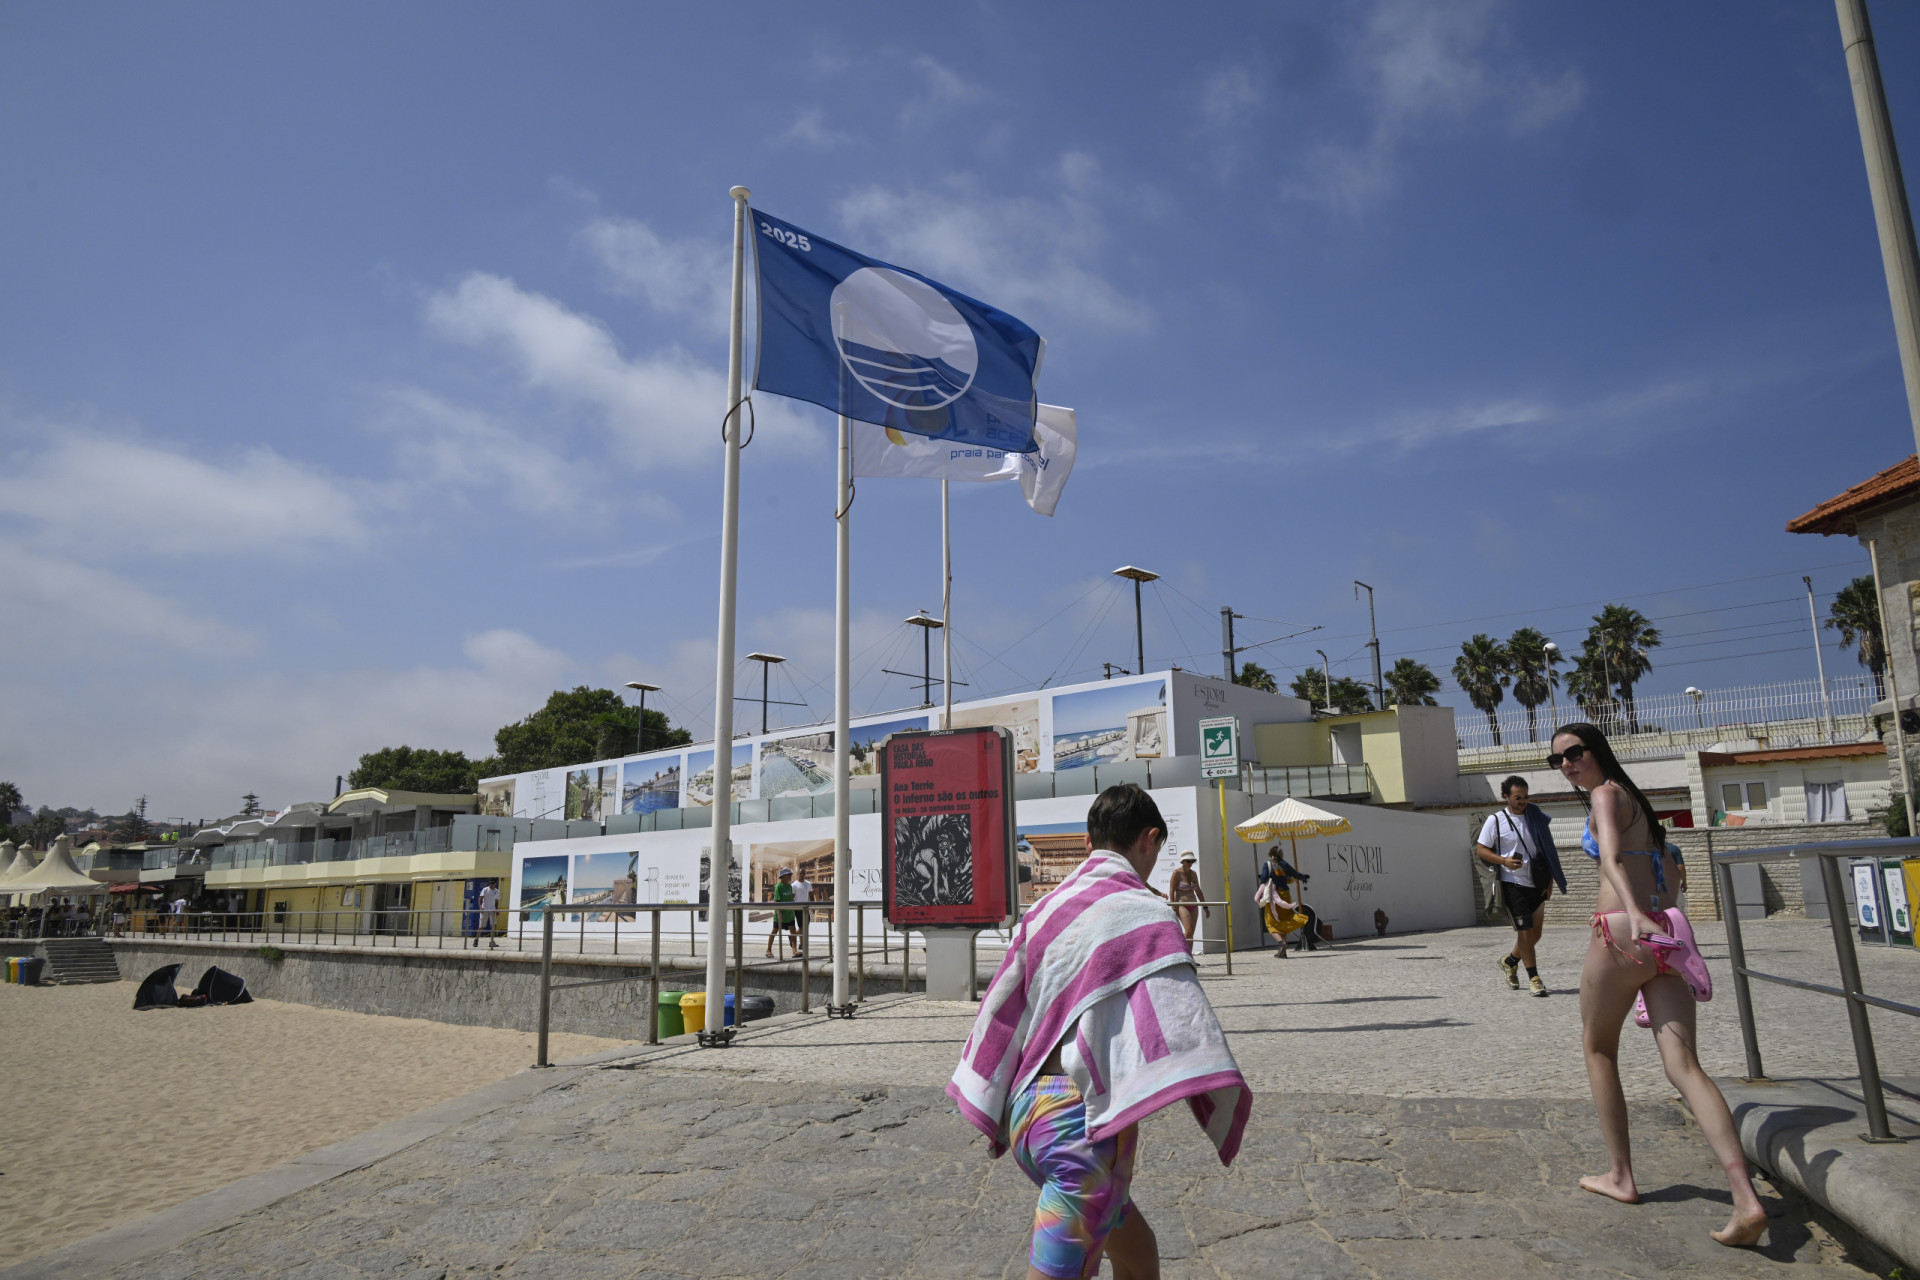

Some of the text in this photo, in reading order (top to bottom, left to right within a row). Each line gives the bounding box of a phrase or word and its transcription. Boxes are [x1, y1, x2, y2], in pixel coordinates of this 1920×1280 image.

[761, 222, 811, 252] 2025
[950, 449, 982, 461] praia
[894, 743, 924, 753] CASA DAS
[894, 758, 933, 769] PAULA REGO
[894, 782, 934, 792] Ana Torrie
[894, 790, 998, 804] O inferno são os outros
[1326, 843, 1389, 874] ESTORIL
